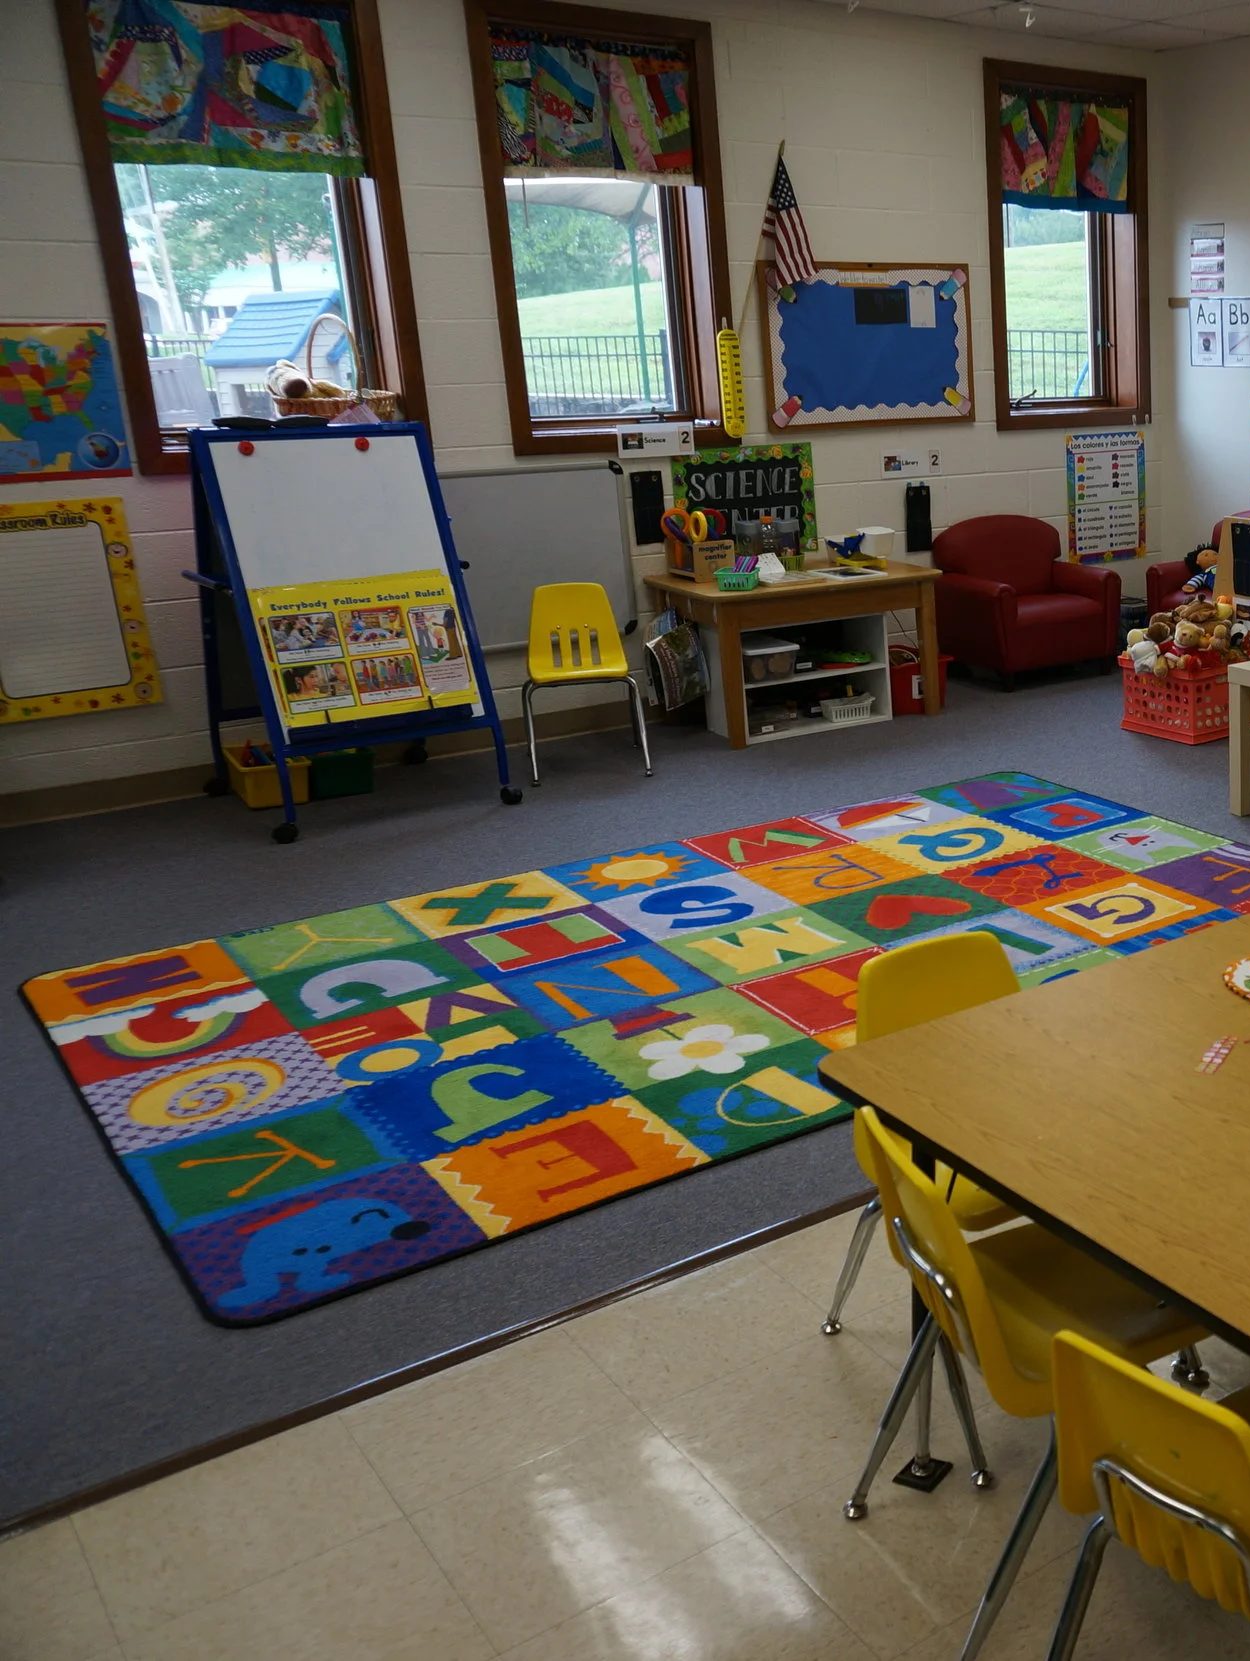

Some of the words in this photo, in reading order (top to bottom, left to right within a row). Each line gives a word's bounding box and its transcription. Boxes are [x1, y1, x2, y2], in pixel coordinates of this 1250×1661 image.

[1196, 303, 1216, 325] Aa
[1229, 303, 1249, 325] Bb
[681, 431, 690, 444] 2
[1082, 441, 1104, 449] colores
[1110, 439, 1118, 447] las
[931, 454, 939, 466] 2
[688, 466, 799, 502] SCIENCE
[50, 513, 85, 526] Rules
[698, 544, 733, 553] magnifier
[704, 553, 727, 561] center
[270, 599, 328, 612] Everybody
[333, 596, 371, 606] Follows
[377, 591, 410, 602] School
[415, 588, 446, 598] Rules!
